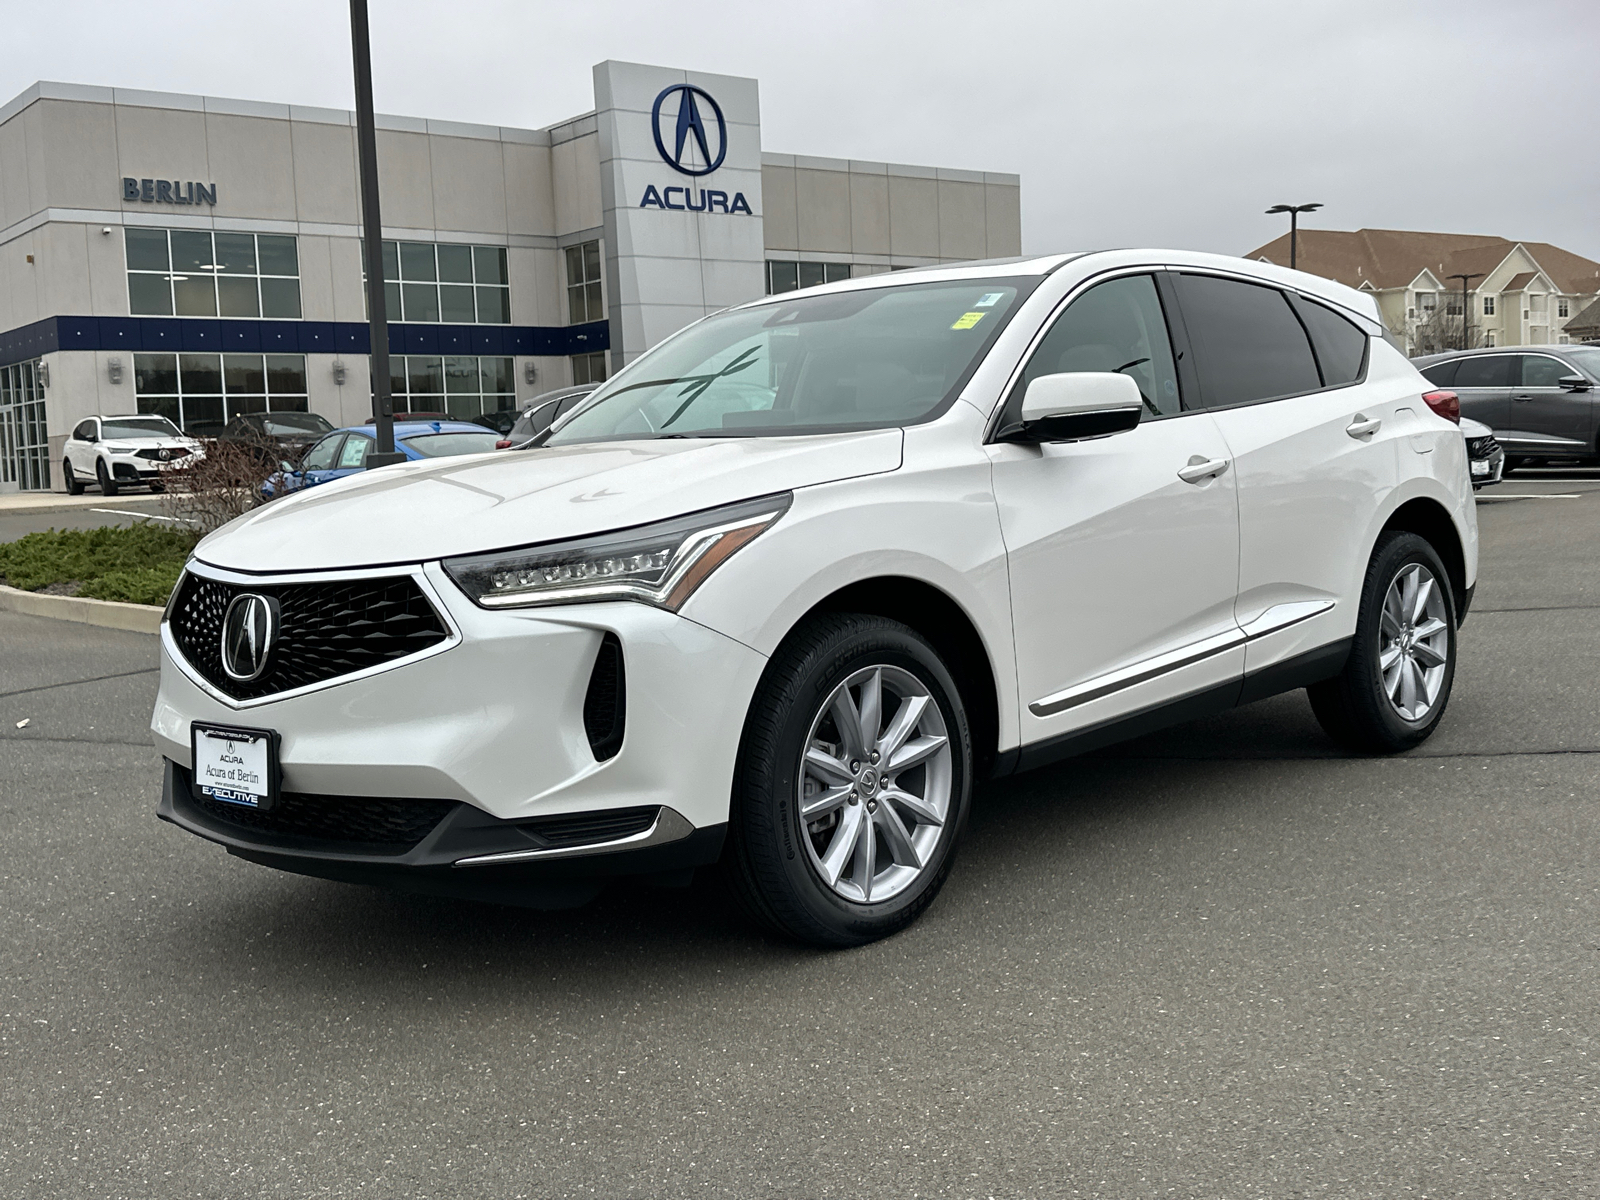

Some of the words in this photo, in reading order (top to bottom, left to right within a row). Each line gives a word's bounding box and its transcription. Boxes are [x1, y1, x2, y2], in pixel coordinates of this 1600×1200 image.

[123, 177, 217, 206] BERLIN
[639, 185, 753, 215] ACURA
[220, 754, 244, 765] ACURA
[206, 764, 226, 778] Acura
[227, 769, 235, 780] of
[237, 768, 259, 784] Berlin
[202, 786, 258, 804] EXECUTIVE
